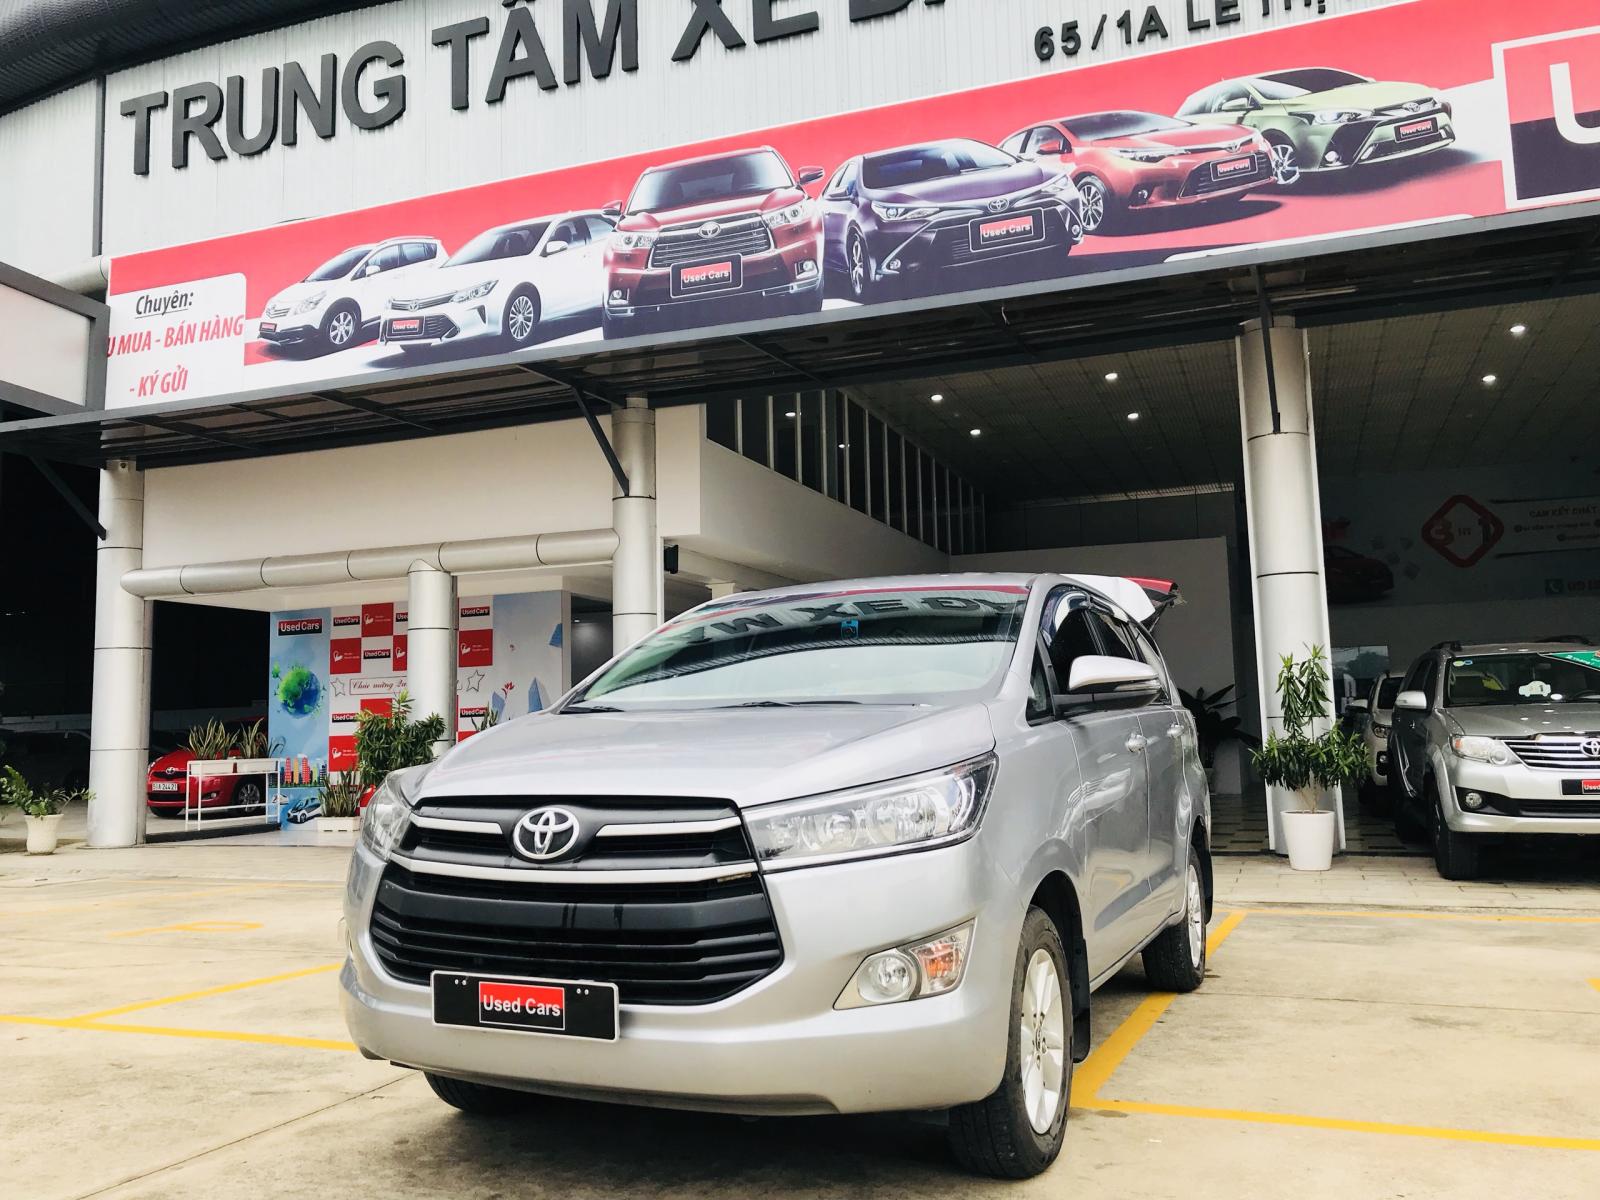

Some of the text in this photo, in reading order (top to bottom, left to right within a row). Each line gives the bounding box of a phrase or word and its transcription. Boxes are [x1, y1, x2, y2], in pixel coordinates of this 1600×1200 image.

[120, 40, 406, 176] TRUNG
[983, 224, 1030, 237] Used Cars
[683, 270, 729, 283] Used Cars
[136, 290, 194, 316] Chuyên:
[117, 330, 151, 355] MUA
[164, 320, 197, 348] BÁN
[199, 314, 244, 342] HÀNG
[138, 370, 159, 397] KÝ
[160, 364, 188, 394] GỬI
[280, 620, 319, 632] Used Cars
[483, 994, 561, 1017] Used Cars
